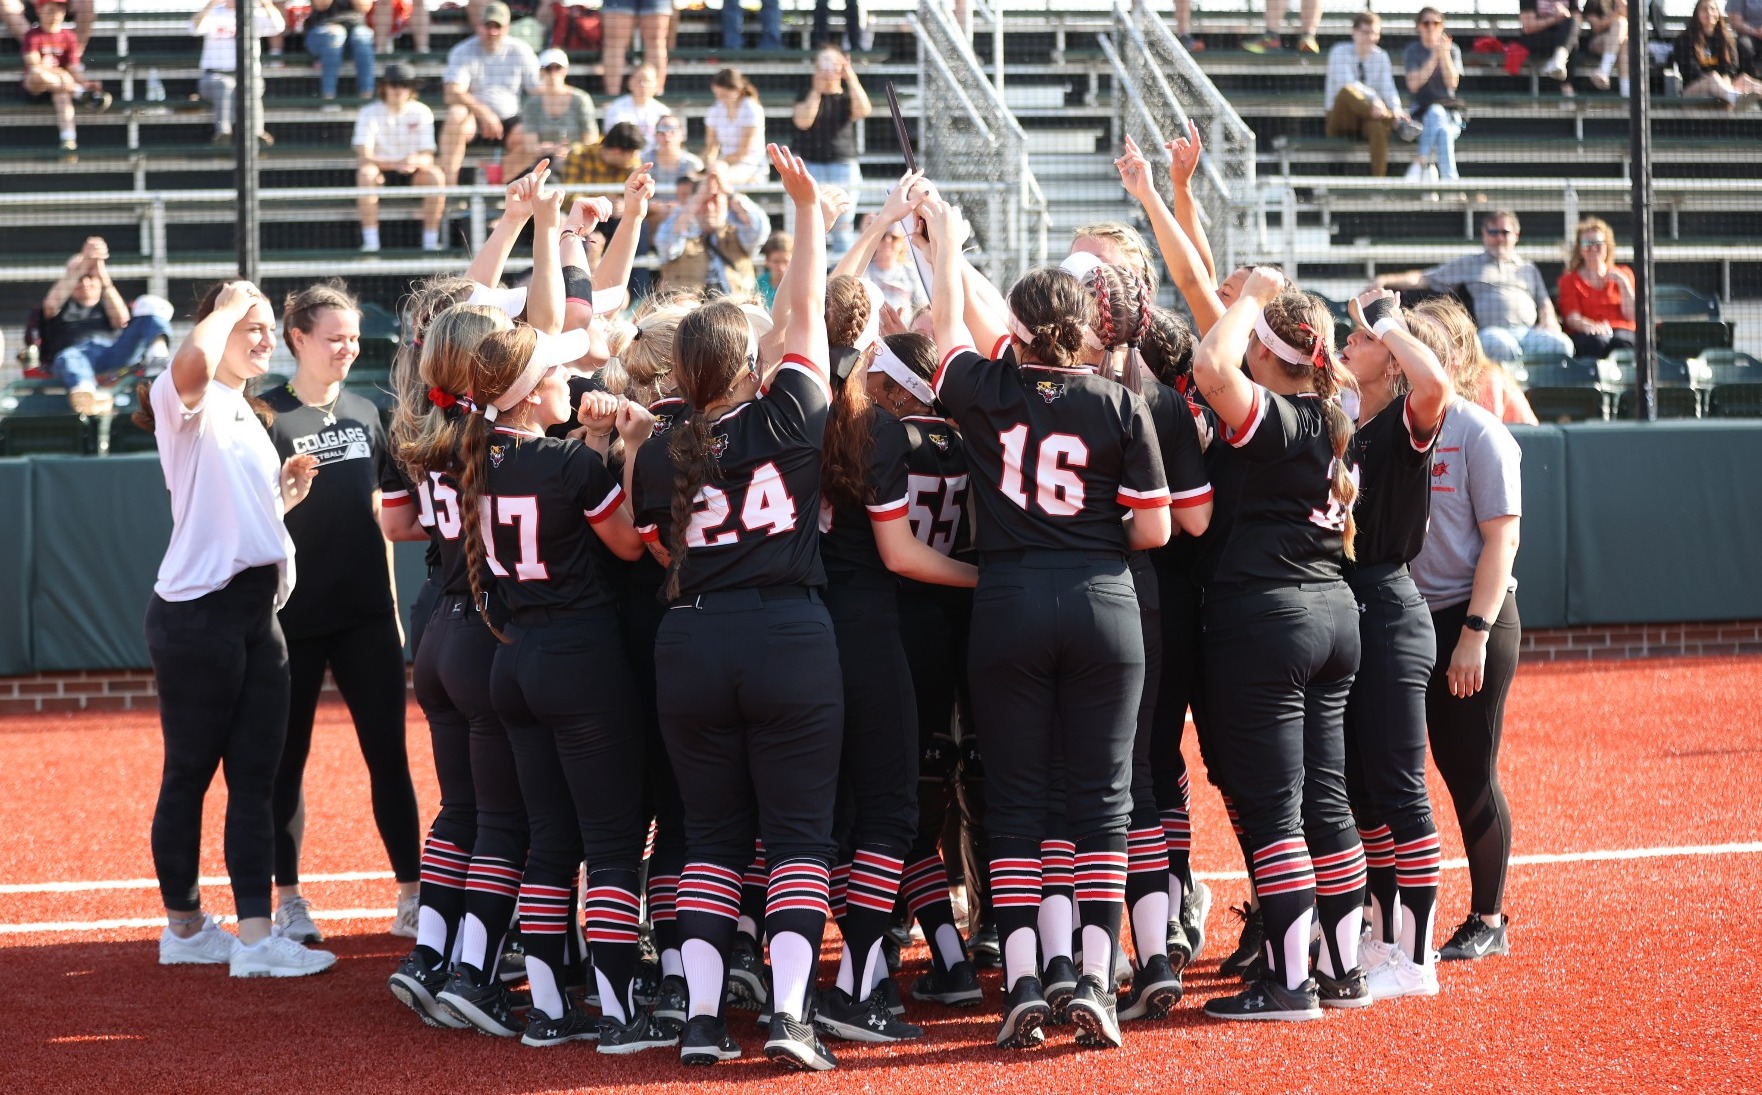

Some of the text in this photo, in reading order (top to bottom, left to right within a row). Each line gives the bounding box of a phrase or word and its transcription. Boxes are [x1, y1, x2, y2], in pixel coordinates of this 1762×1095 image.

[292, 427, 367, 454] COUGARS
[998, 422, 1090, 516] 16
[686, 461, 798, 548] 24
